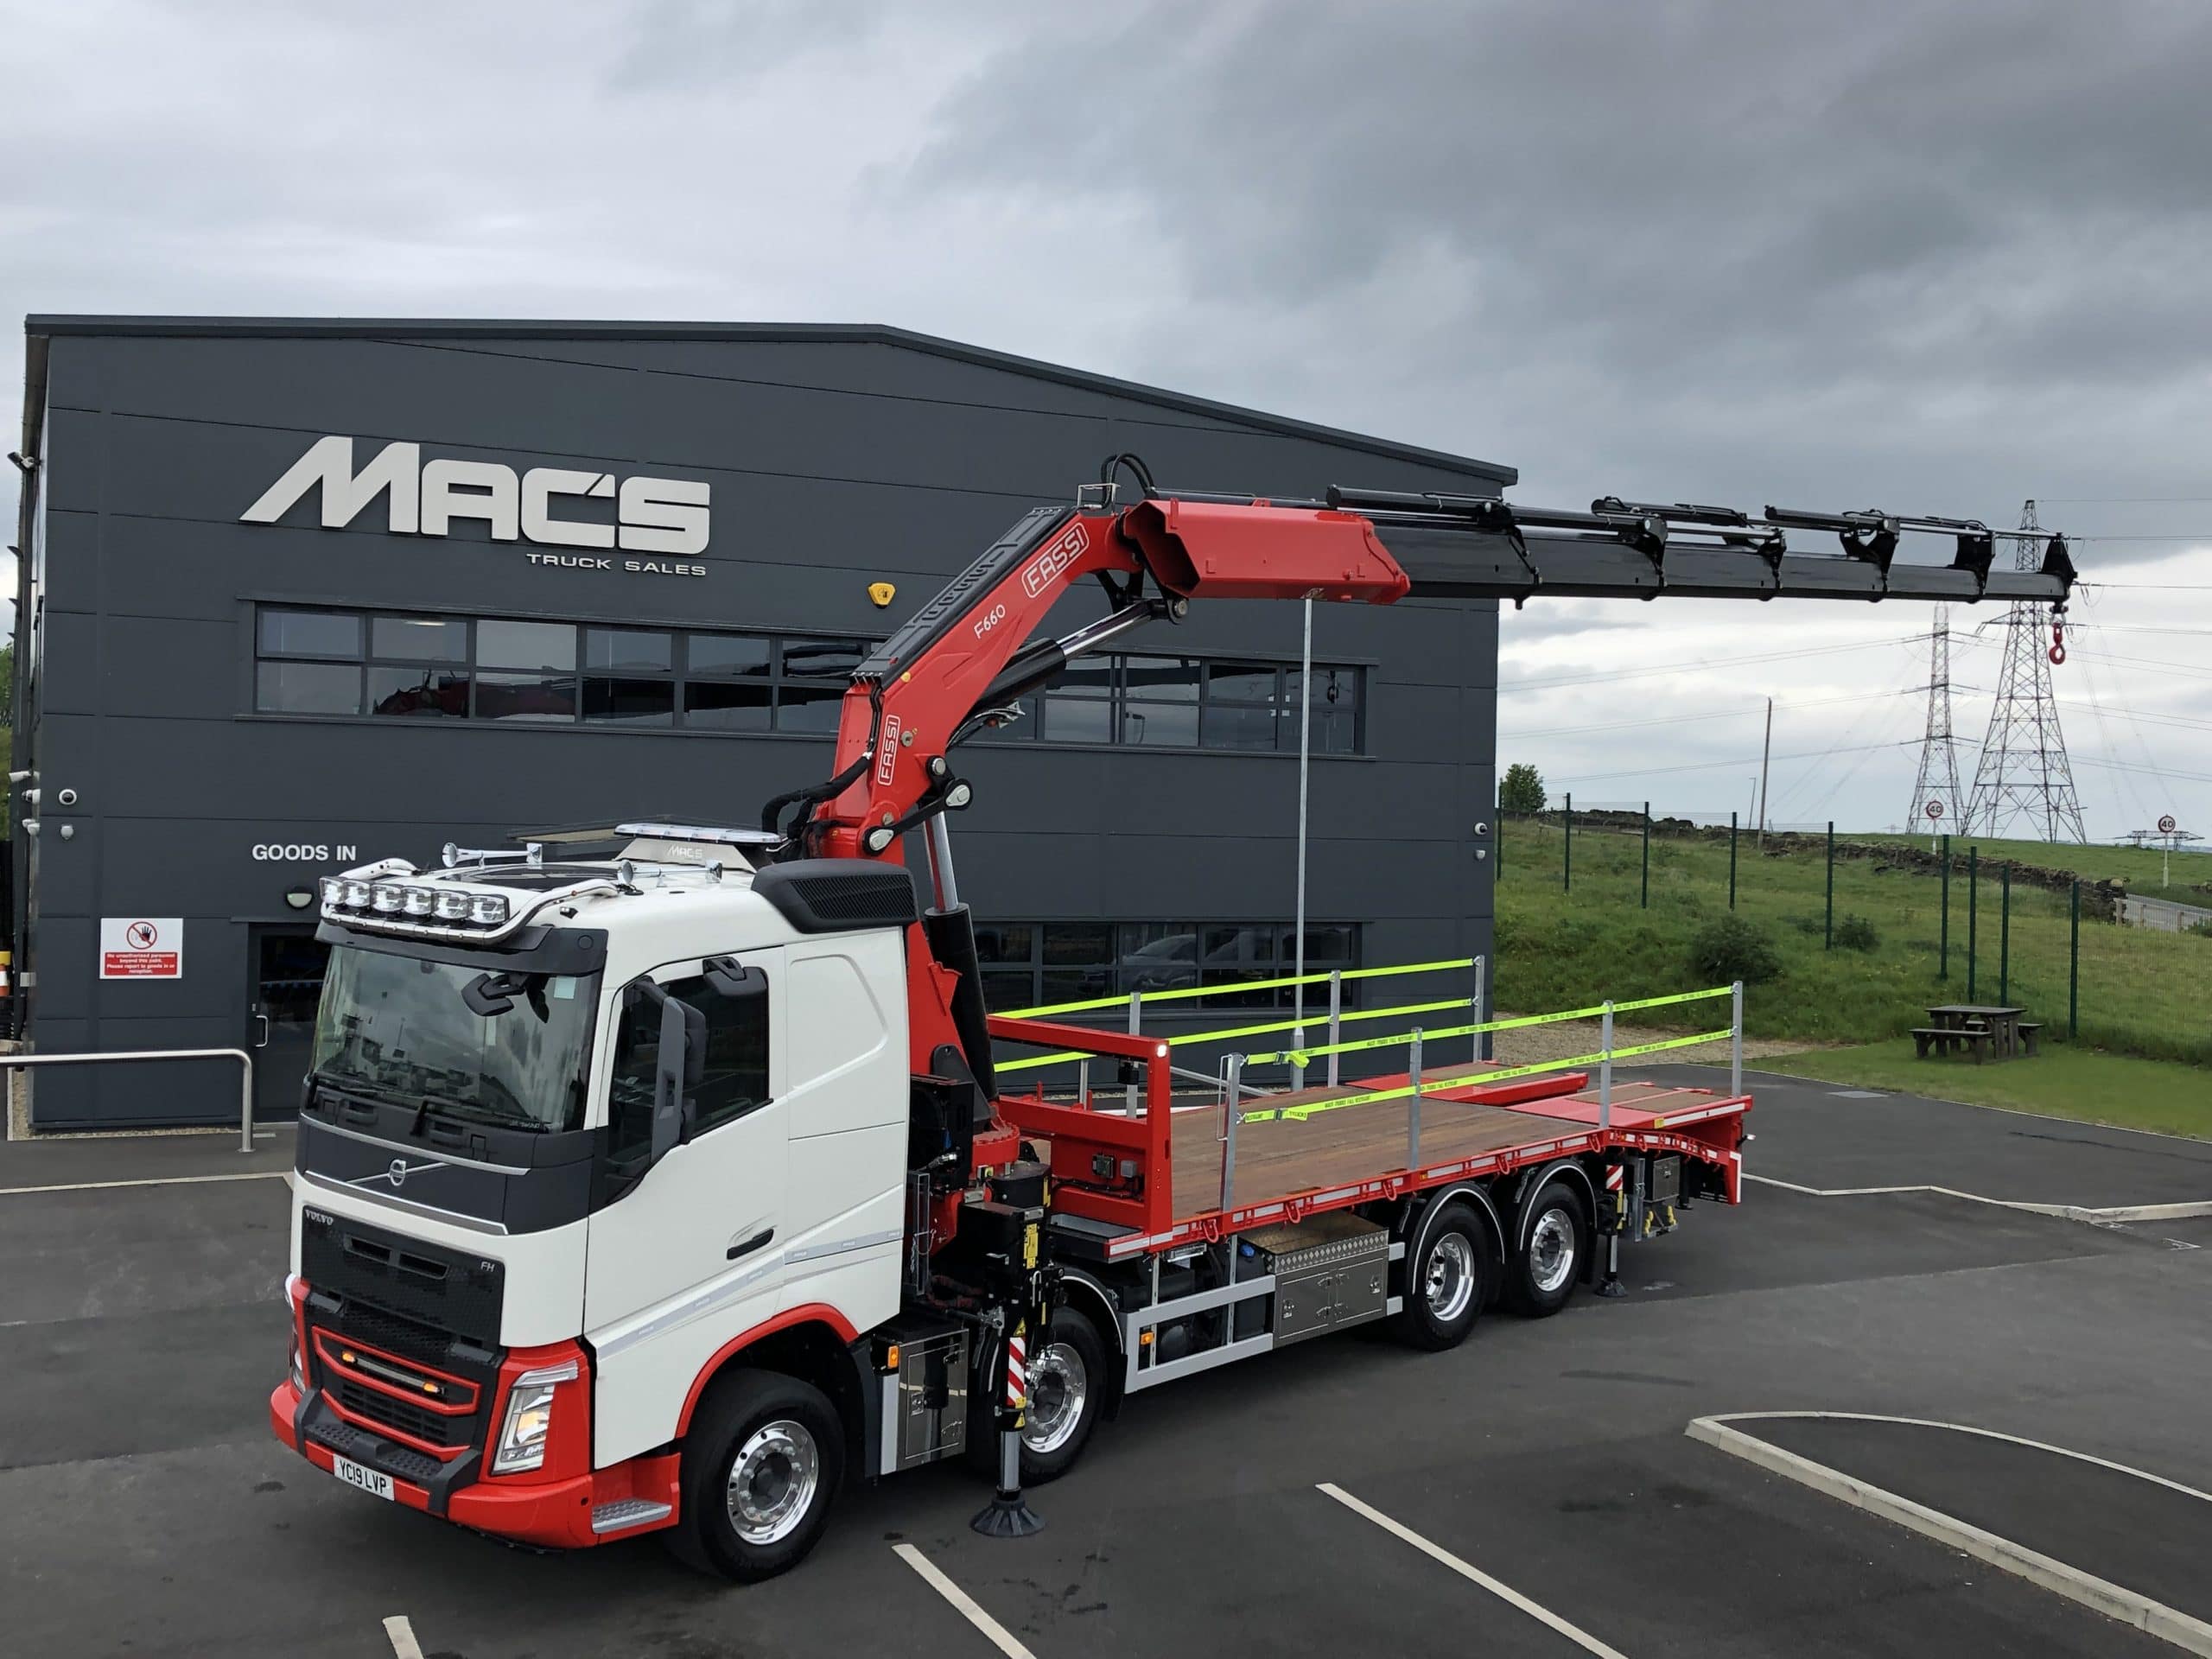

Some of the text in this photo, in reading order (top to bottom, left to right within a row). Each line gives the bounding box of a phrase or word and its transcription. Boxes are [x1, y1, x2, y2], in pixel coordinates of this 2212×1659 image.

[525, 553, 707, 577] TRUCK SALES
[1024, 526, 1086, 594] FASSI
[973, 604, 1007, 639] F660
[880, 720, 899, 780] FASSI
[251, 843, 357, 861] GOODS IN
[305, 1209, 334, 1226] VOLVO
[480, 1261, 495, 1273] FH
[339, 1459, 387, 1494] YC19 LVP
